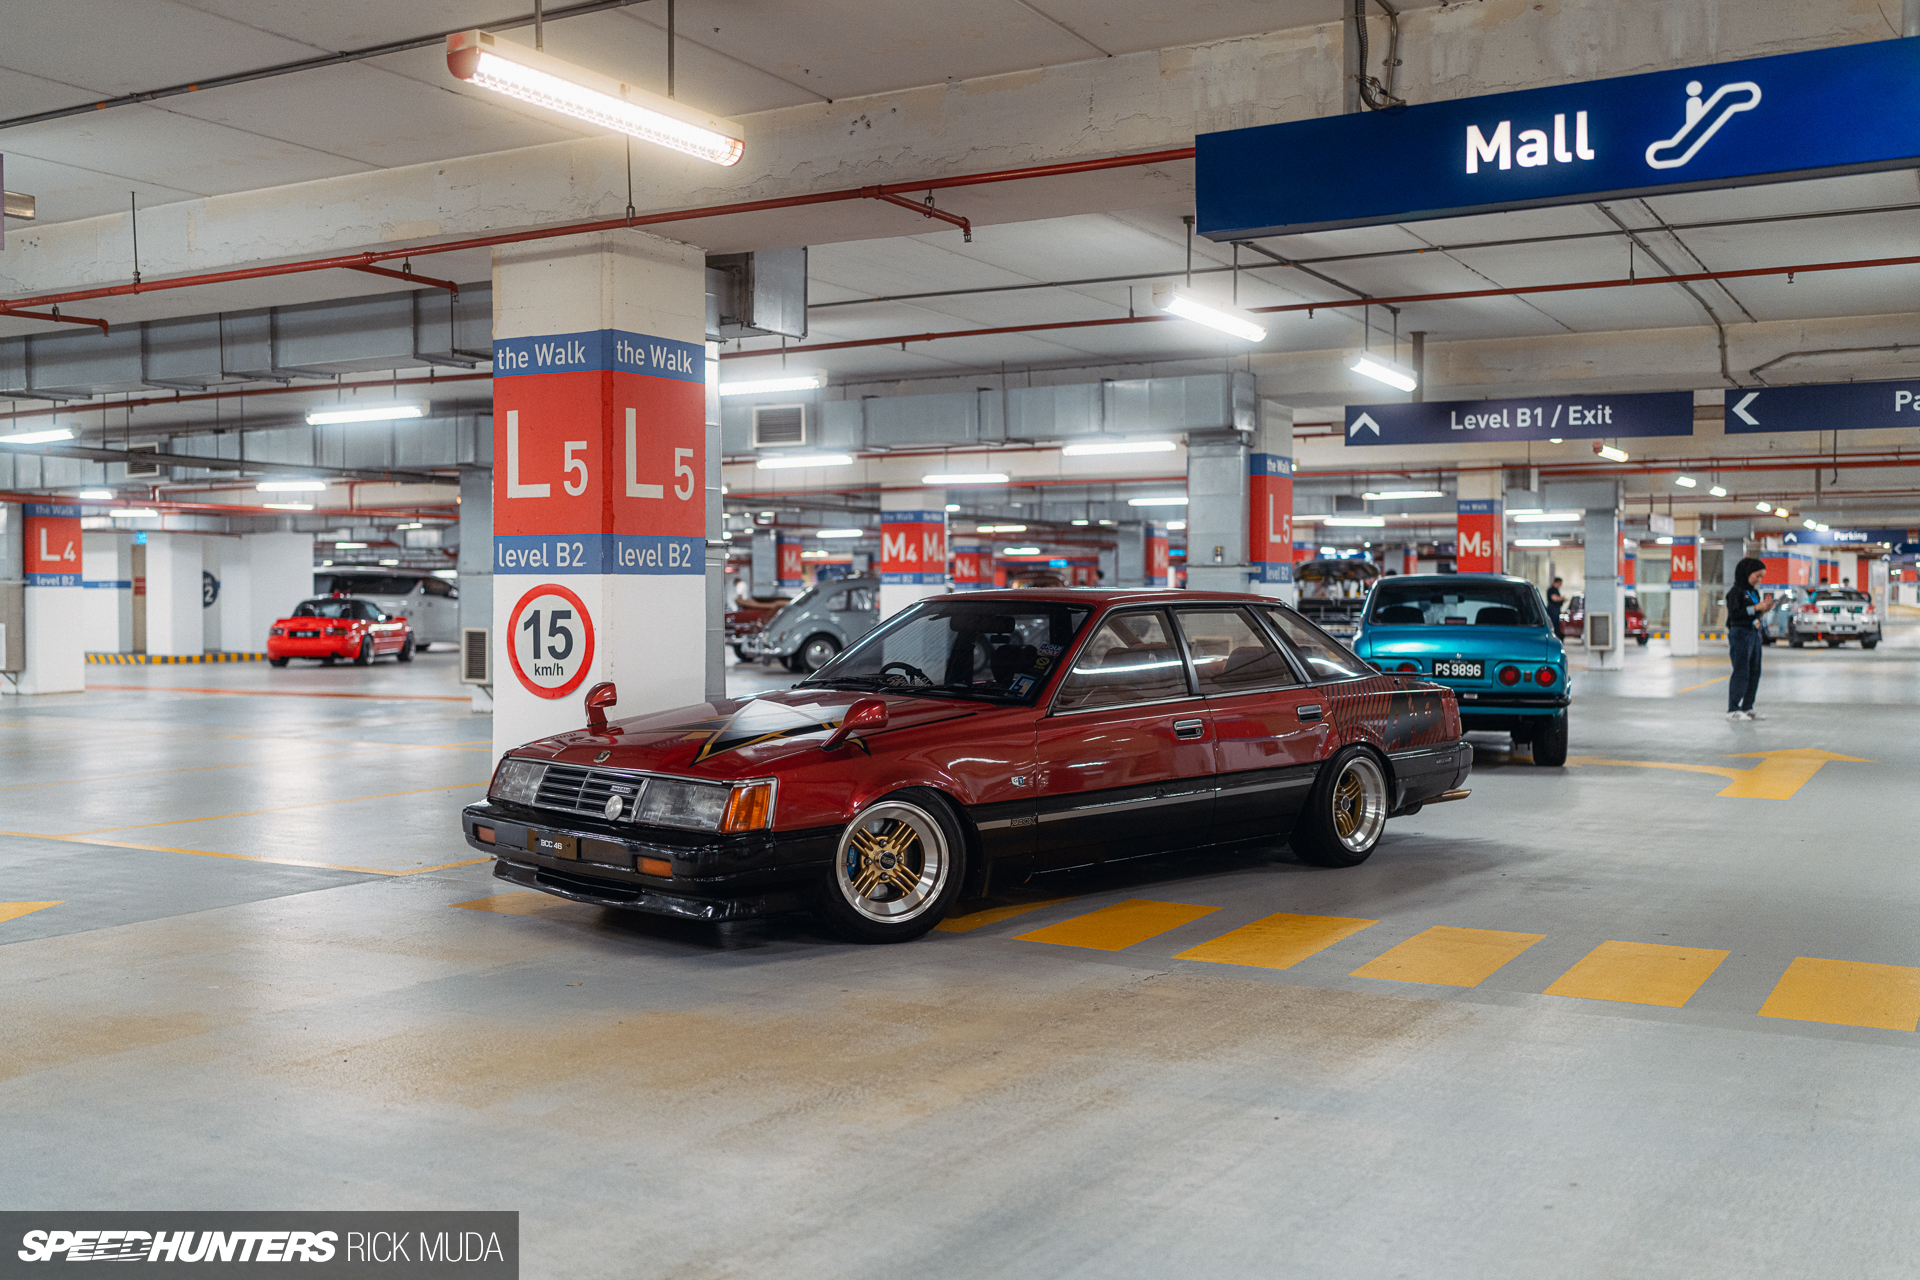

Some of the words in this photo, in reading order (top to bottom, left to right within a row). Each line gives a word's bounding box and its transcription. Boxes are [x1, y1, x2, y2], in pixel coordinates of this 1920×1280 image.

[1466, 110, 1595, 174] Mall
[498, 347, 529, 370] the
[535, 341, 586, 366] Walk
[617, 340, 645, 365] the
[650, 344, 693, 374] Walk
[1451, 409, 1510, 430] Level
[1516, 407, 1543, 428] B1
[1551, 404, 1562, 428] /
[1568, 404, 1612, 426] Exit
[1266, 458, 1277, 472] the
[1277, 460, 1290, 474] Walk
[52, 506, 75, 515] Walk
[883, 532, 918, 563] M4
[1459, 531, 1491, 557] M5
[1834, 532, 1868, 542] Parking
[499, 542, 549, 567] level
[556, 542, 585, 567] B2
[618, 542, 663, 567] level
[669, 543, 692, 567] B2
[36, 576, 60, 586] level
[62, 575, 75, 586] B2
[1266, 566, 1280, 581] level
[523, 610, 574, 660] 15
[1039, 648, 1060, 656] MOLY
[534, 663, 564, 676] km/h
